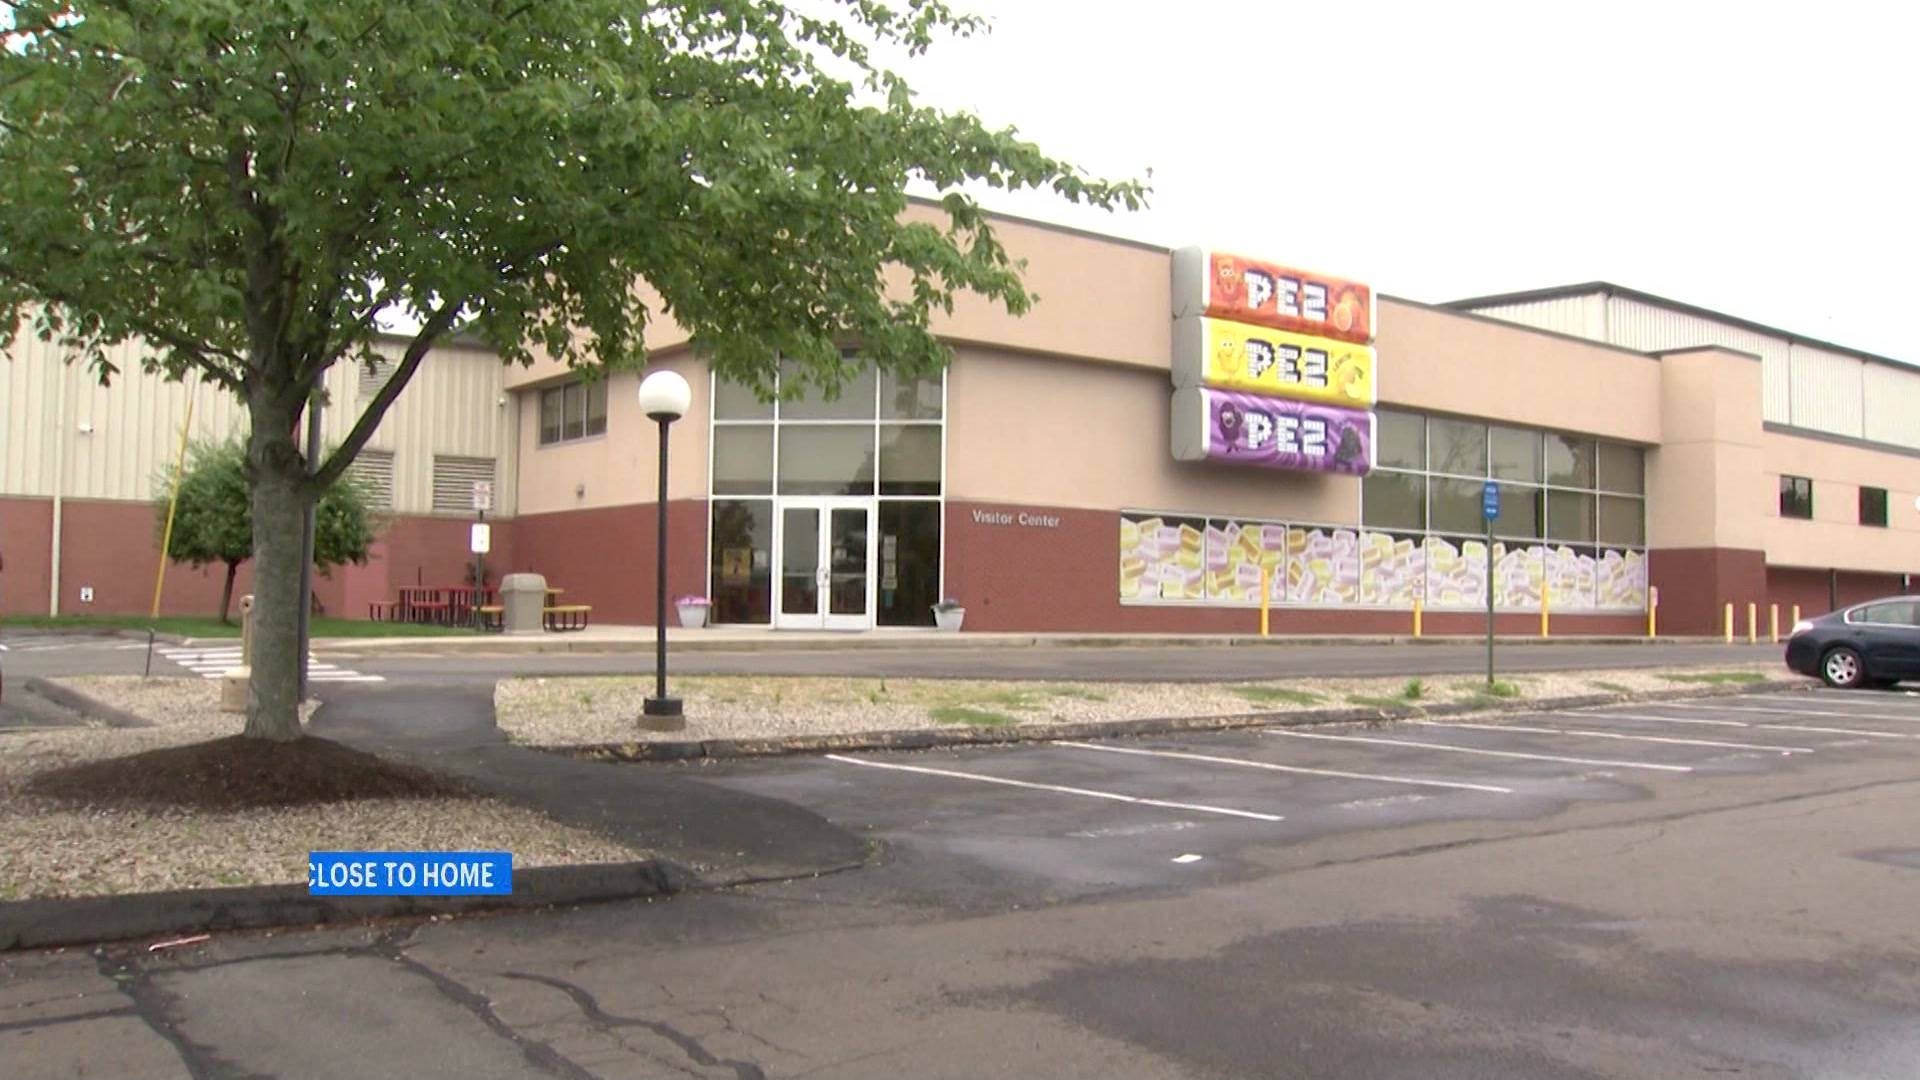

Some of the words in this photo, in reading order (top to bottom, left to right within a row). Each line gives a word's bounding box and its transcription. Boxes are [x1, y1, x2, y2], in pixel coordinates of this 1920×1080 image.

[1244, 268, 1328, 321] PEZ
[1244, 338, 1328, 388] PEZ
[1244, 409, 1328, 456] PEZ
[972, 509, 1013, 524] Visitor
[1018, 513, 1060, 527] Center
